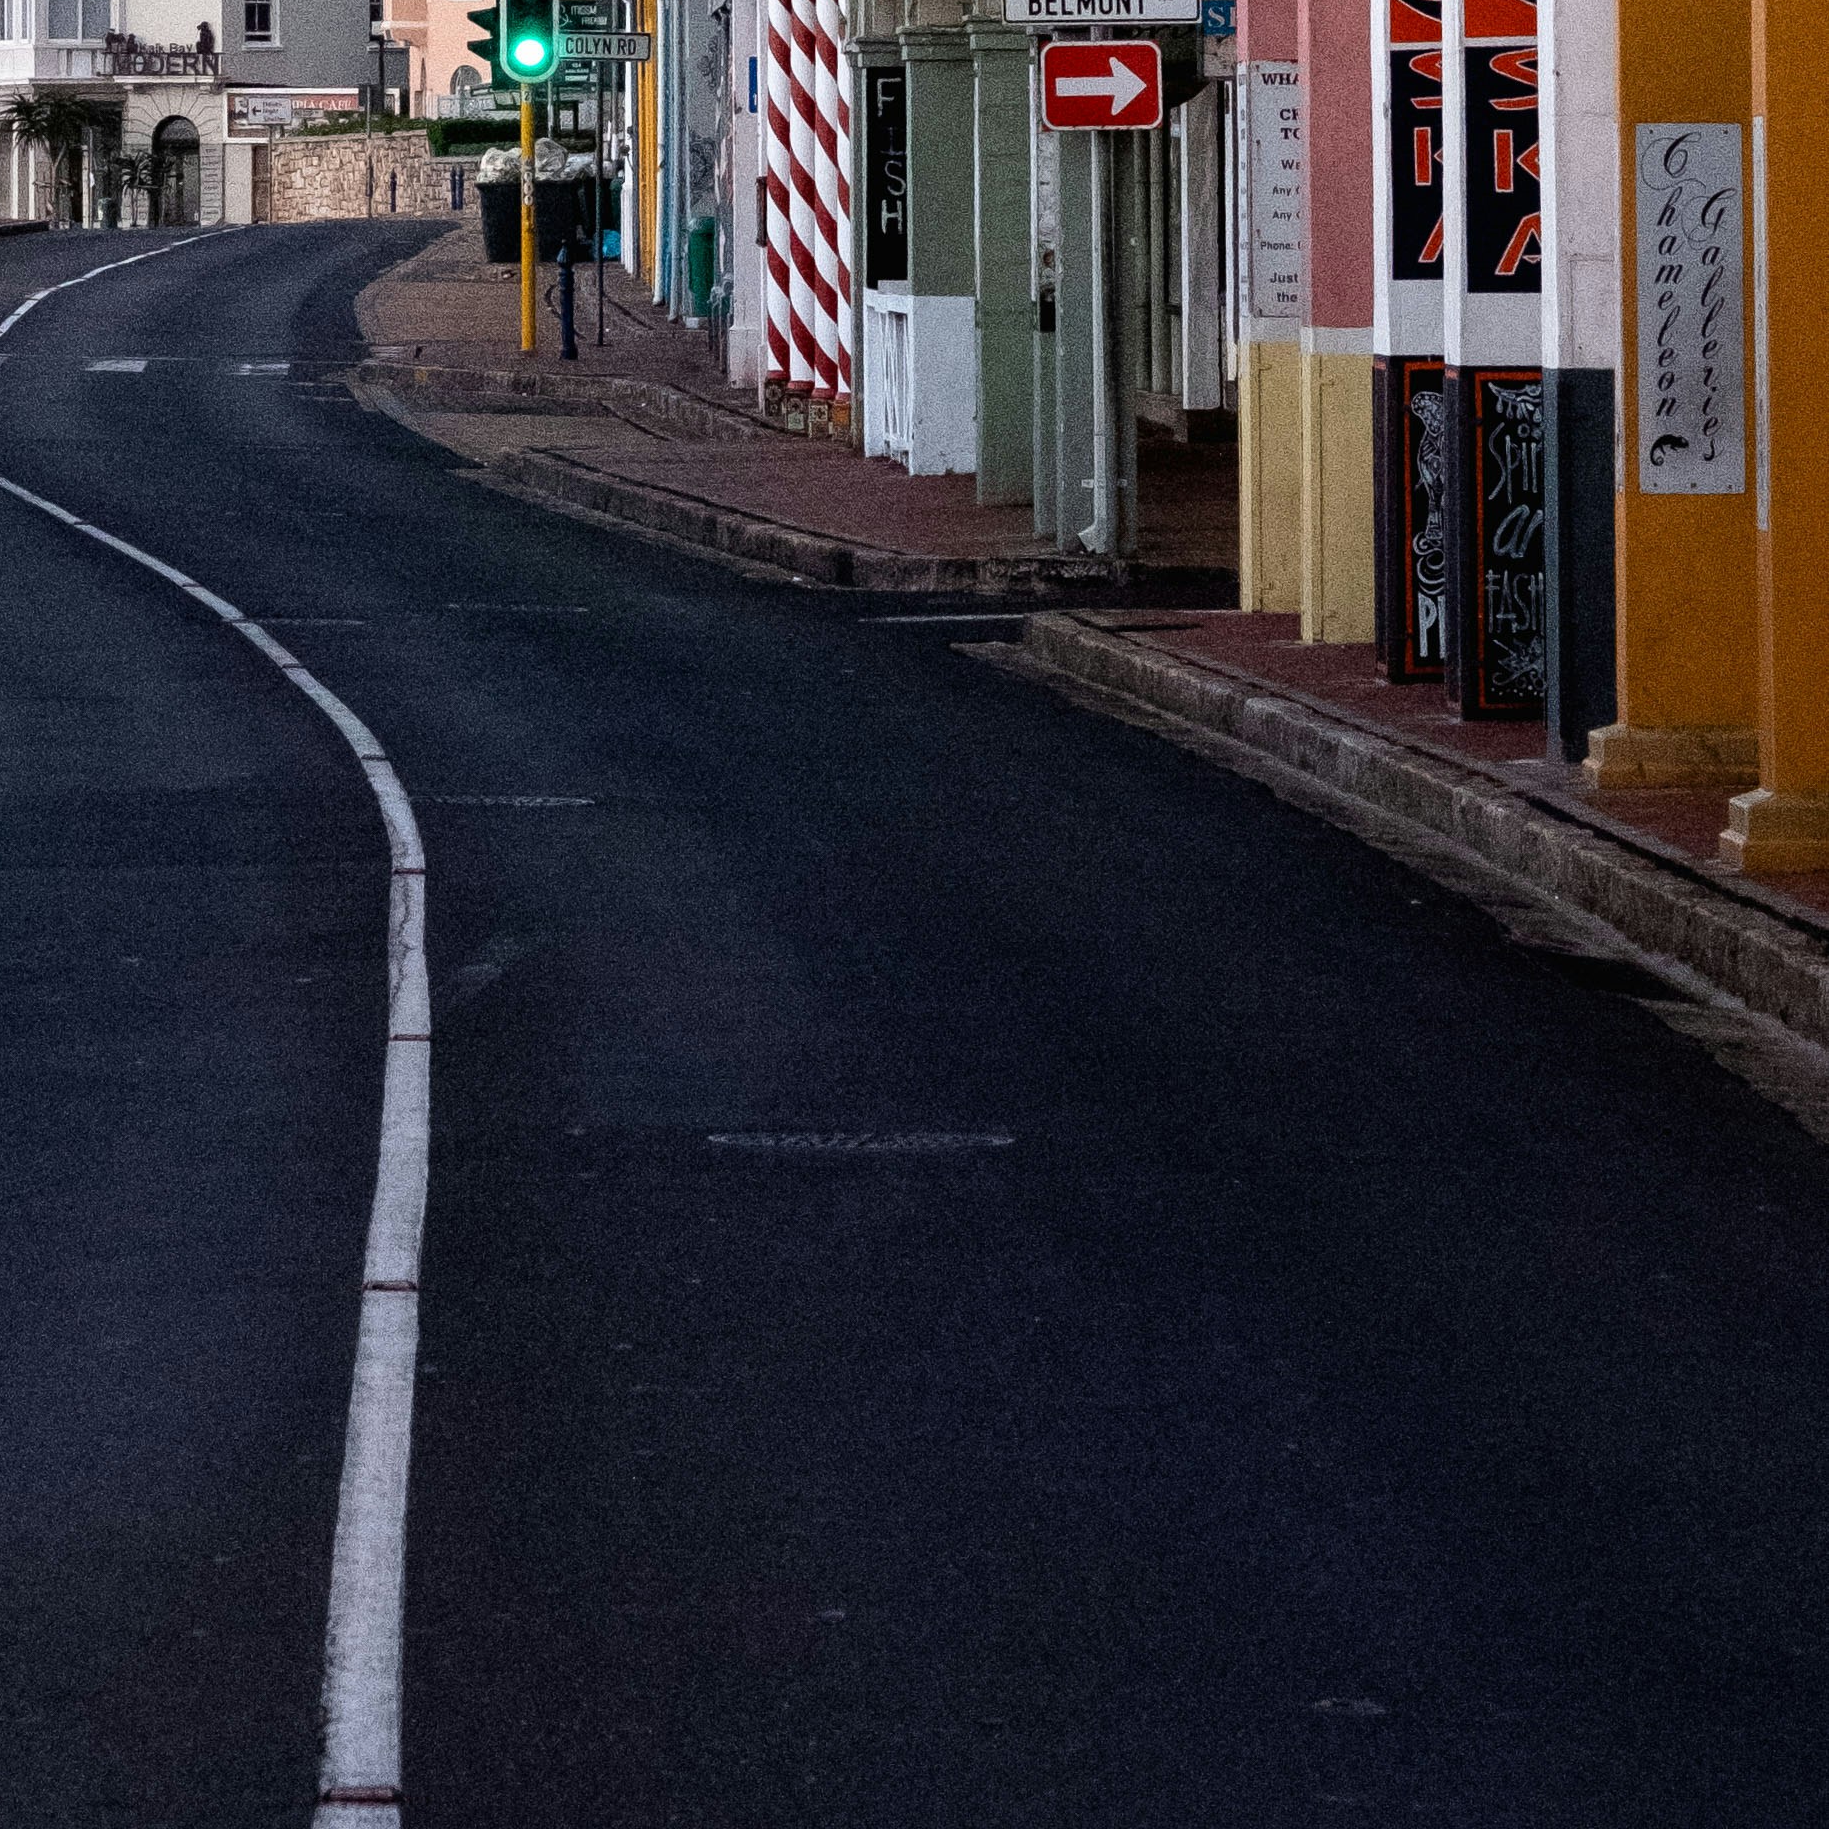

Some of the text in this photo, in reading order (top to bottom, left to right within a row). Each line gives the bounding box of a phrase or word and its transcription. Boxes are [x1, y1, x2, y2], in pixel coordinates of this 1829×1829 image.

[169, 42, 193, 54] Bay
[566, 37, 637, 56] COLYN RD
[113, 53, 219, 75] MODERN
[877, 77, 907, 235] FISH
[1272, 185, 1292, 197] Any
[1272, 210, 1292, 222] Any
[1270, 272, 1299, 283] Just
[1640, 131, 1707, 418] Chameleon
[1276, 292, 1298, 303] the
[1681, 188, 1737, 461] Galleries
